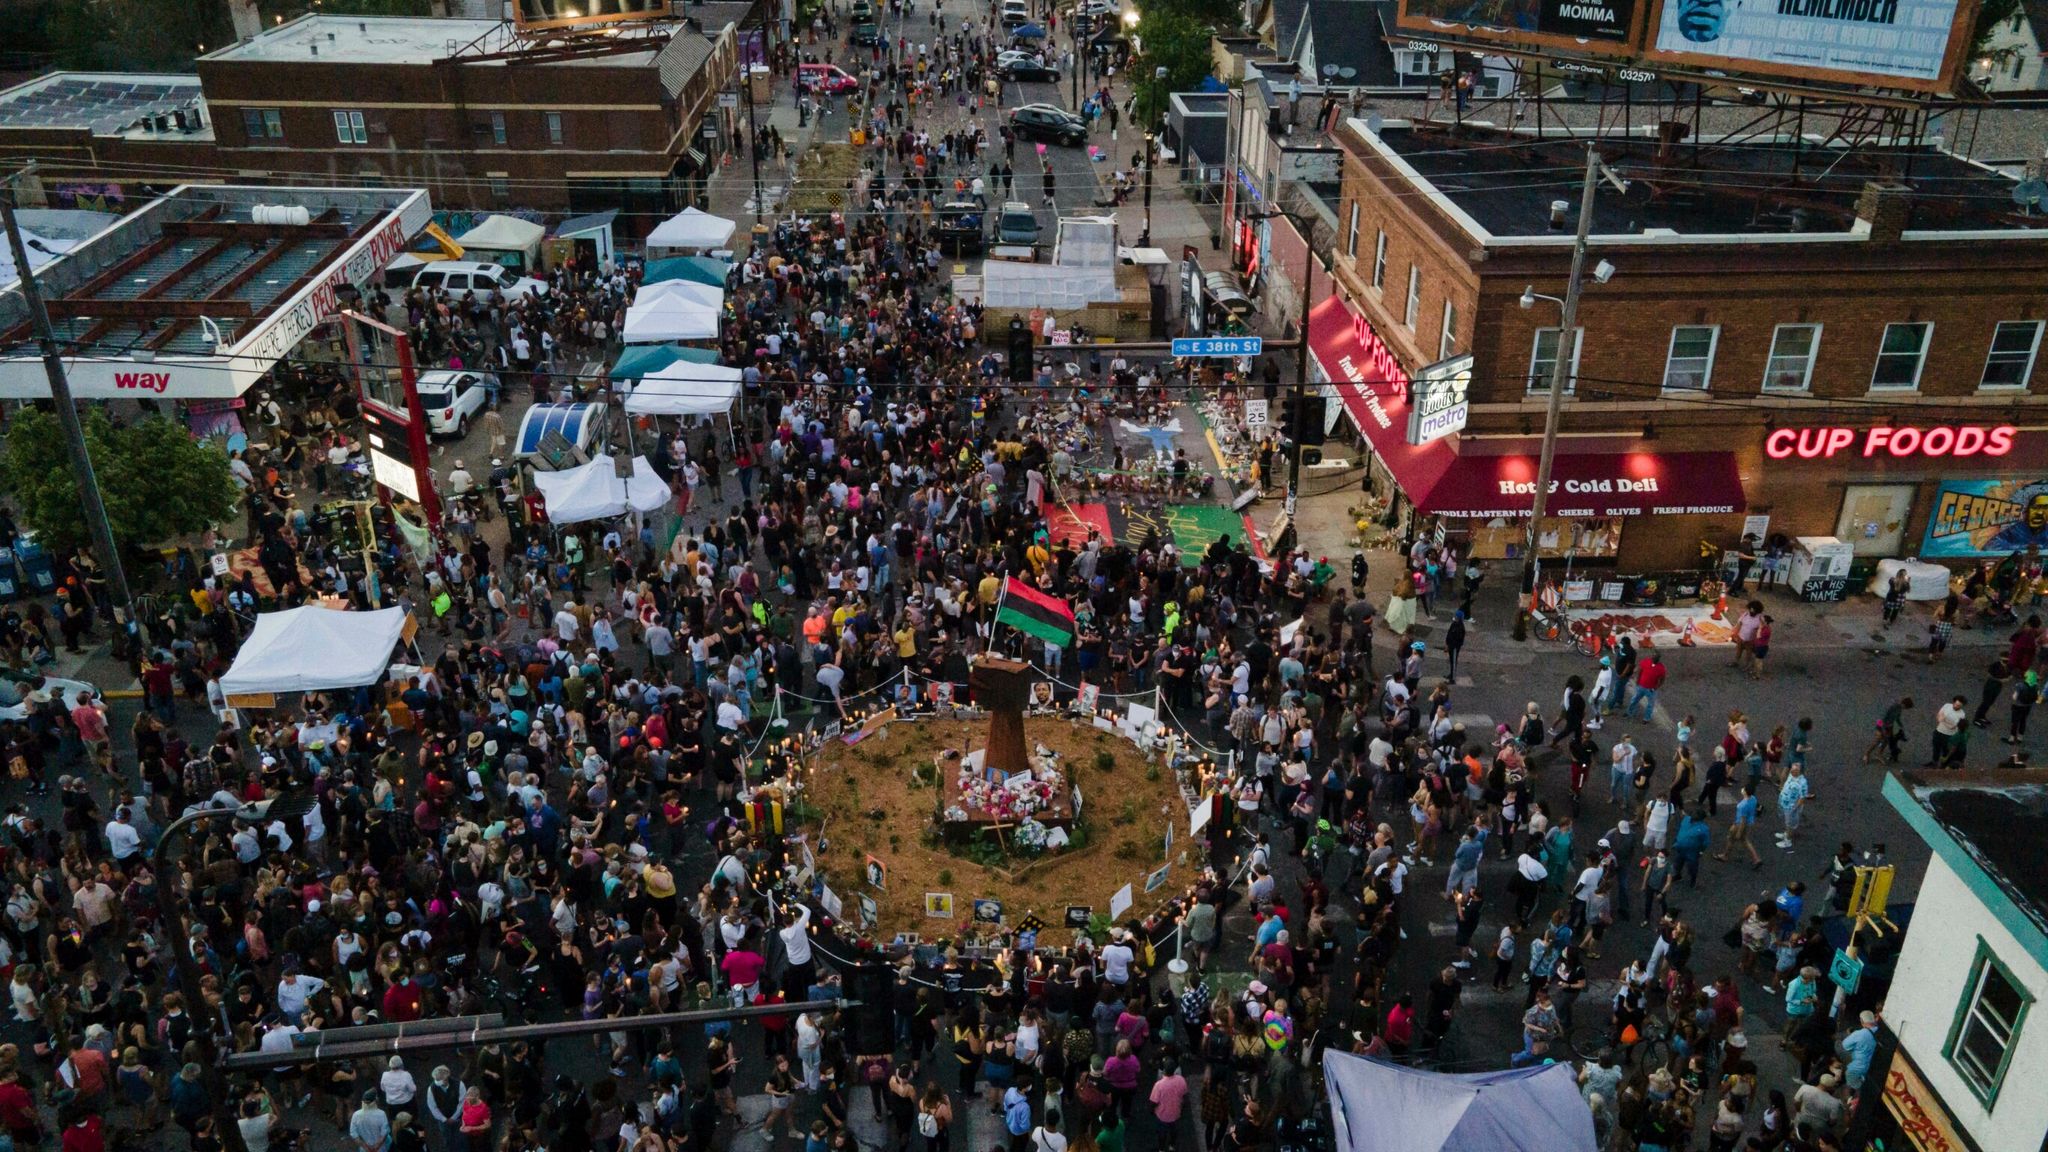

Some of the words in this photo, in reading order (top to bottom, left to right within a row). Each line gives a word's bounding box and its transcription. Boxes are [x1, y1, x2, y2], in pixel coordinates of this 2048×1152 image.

[1559, 4, 1615, 22] MOMMA
[1408, 41, 1438, 53] 032540
[1620, 69, 1655, 82] 032570
[251, 327, 282, 369] WHERE
[280, 300, 312, 345] THERES
[370, 216, 405, 270] POWER
[1192, 342, 1200, 352] E
[1206, 342, 1237, 352] 38th
[1243, 341, 1258, 352] St
[1353, 313, 1372, 351] CUP
[1372, 336, 1407, 403] FOODS
[114, 373, 171, 394] way
[1338, 355, 1359, 378] Fresh
[1366, 395, 1392, 429] Produce
[1420, 392, 1454, 416] Foods
[1249, 412, 1265, 423] 25
[1424, 407, 1465, 432] metro
[1766, 428, 1854, 458] CUP
[1863, 426, 2016, 457] FOODS
[1498, 480, 1537, 494] Hot
[1565, 479, 1612, 493] Cold
[1616, 478, 1659, 493] Deli
[1470, 510, 1516, 518] EASTERN
[1557, 508, 1595, 516] CHEESE
[1606, 508, 1641, 516] OLIVES
[1652, 506, 1685, 515] FRESH
[1686, 505, 1733, 514] PRODUCE
[1932, 492, 2023, 538] GEORGE
[1806, 580, 1824, 591] SAY
[1829, 579, 1846, 590] HIS
[1809, 589, 1839, 601] NAME
